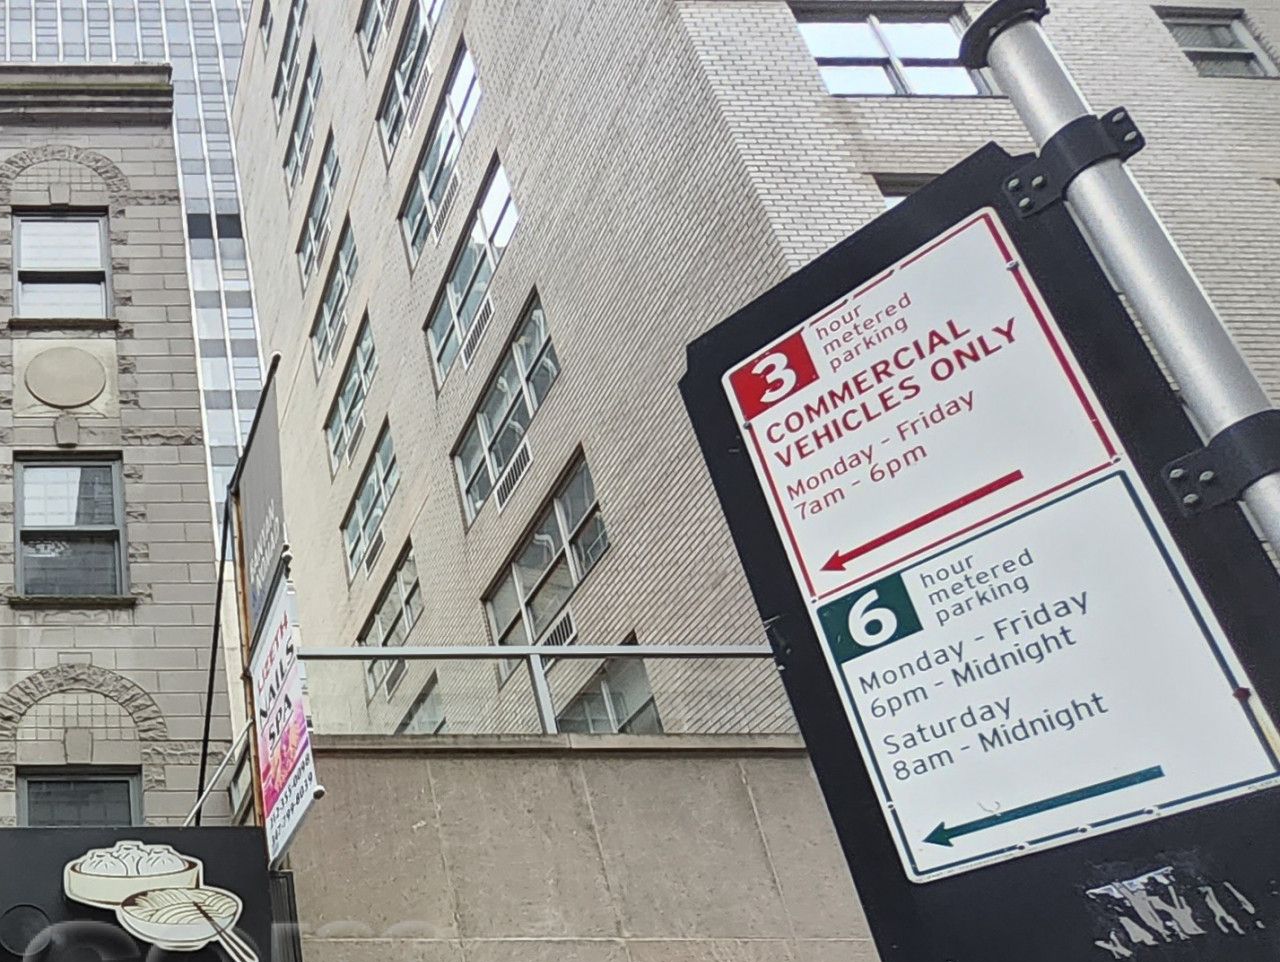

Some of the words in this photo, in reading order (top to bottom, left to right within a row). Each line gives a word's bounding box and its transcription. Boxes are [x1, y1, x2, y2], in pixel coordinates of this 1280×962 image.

[814, 304, 863, 342] hour
[821, 292, 912, 356] metered
[828, 315, 909, 374] parking
[751, 350, 798, 402] 3
[765, 318, 971, 446] COMMERCIAL
[773, 376, 922, 468] VEHICLES
[932, 318, 1018, 382] ONLY
[784, 440, 875, 500] Monday
[896, 389, 976, 442] Friday
[793, 480, 846, 522] 7am
[868, 443, 929, 488] 6pm
[919, 553, 976, 588] hour
[927, 548, 1035, 606] metered
[935, 572, 1032, 627] parking
[847, 588, 898, 648] 6
[858, 641, 965, 695] Monday
[994, 588, 1091, 643] Friday
[259, 634, 295, 728] NAILS
[870, 683, 929, 720] 6pm
[951, 624, 1079, 690] Midnight
[267, 691, 293, 753] SPA
[882, 696, 1013, 756] Saturday
[893, 750, 955, 782] 8am
[977, 691, 1110, 755] Midnight
